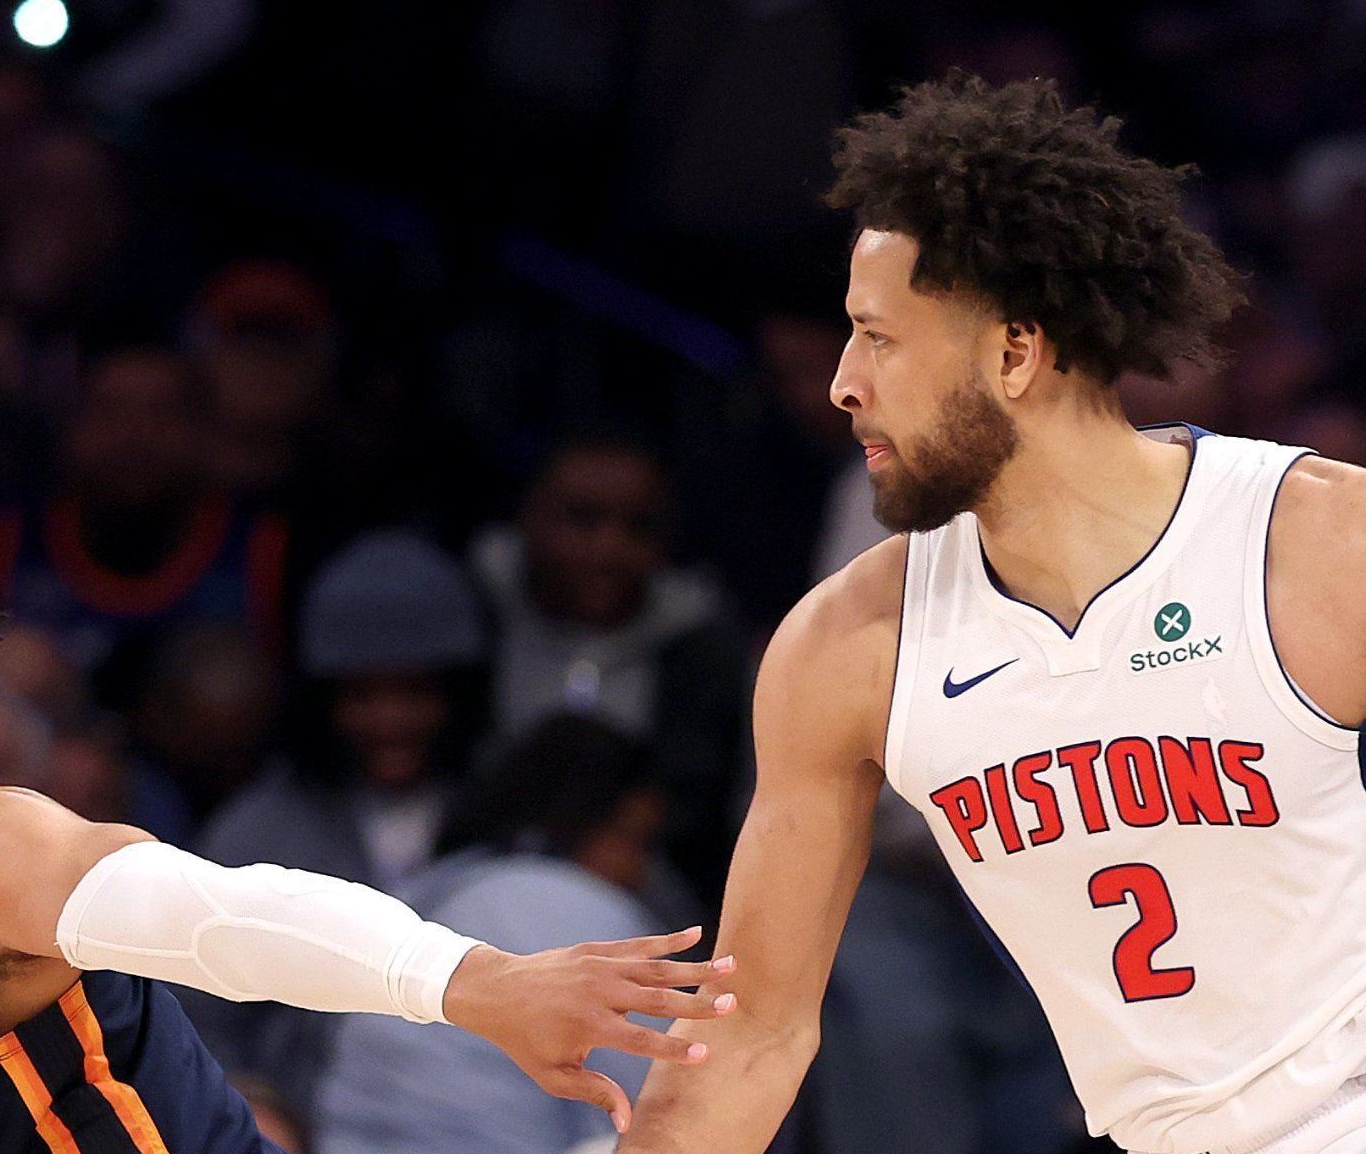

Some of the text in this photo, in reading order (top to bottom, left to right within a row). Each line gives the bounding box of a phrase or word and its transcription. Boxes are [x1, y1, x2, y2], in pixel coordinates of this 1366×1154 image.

[1130, 635, 1223, 672] StockX
[930, 735, 1280, 863] PISTONS
[1087, 862, 1196, 1003] 2
